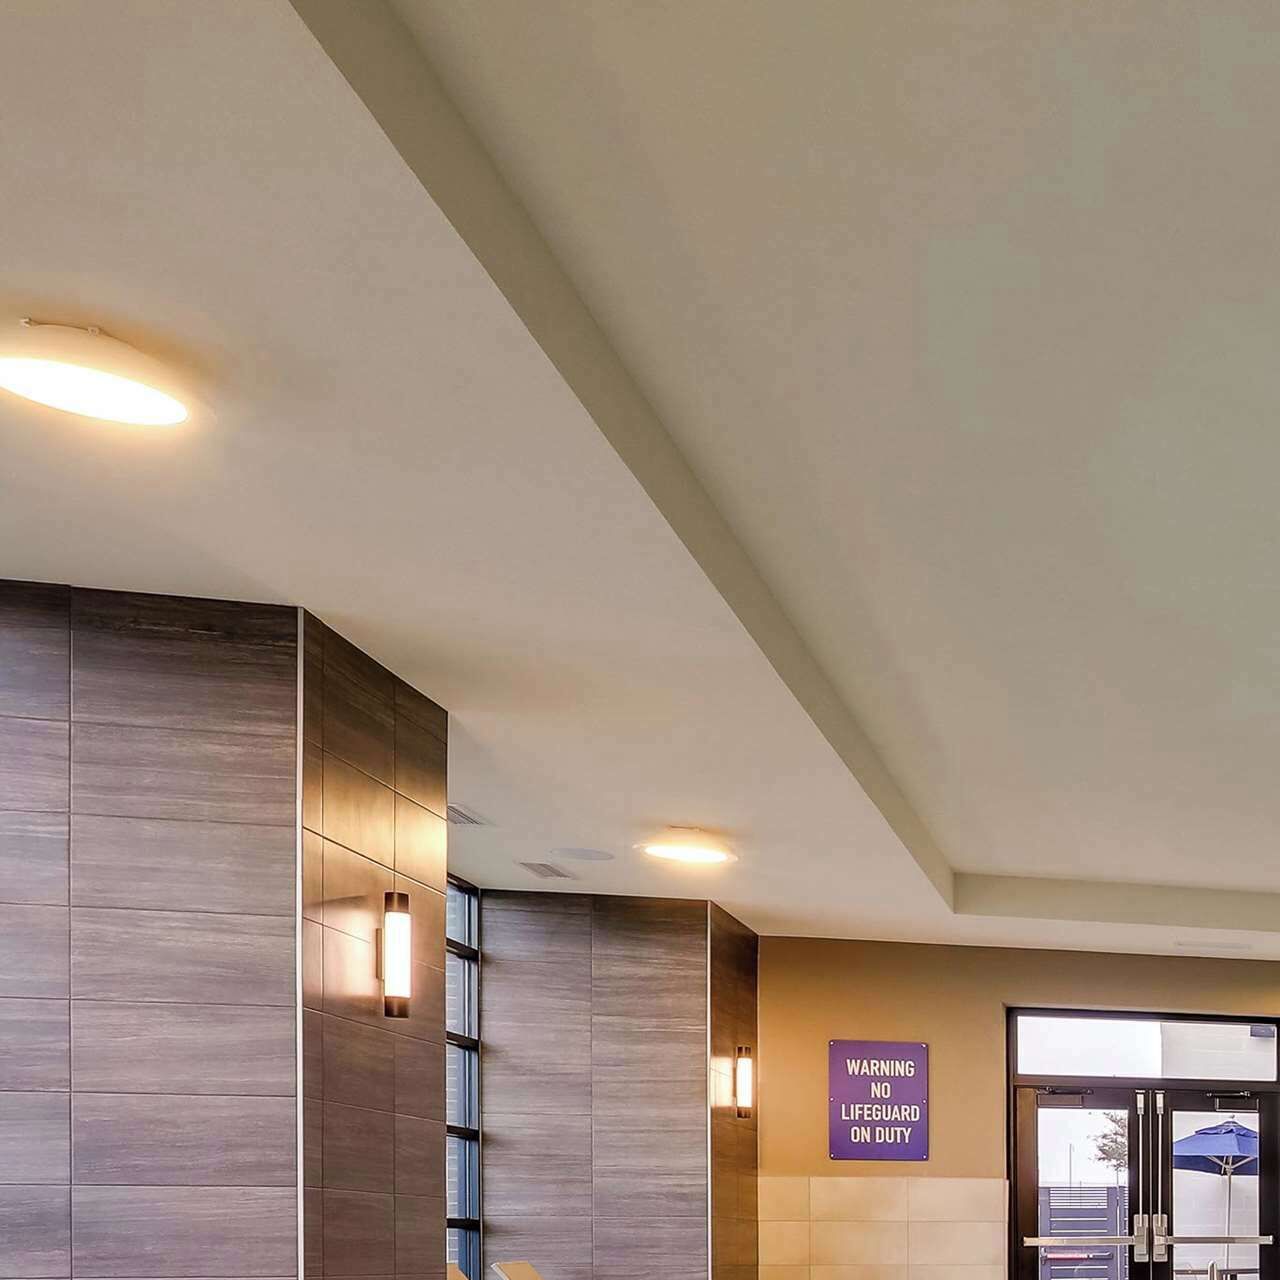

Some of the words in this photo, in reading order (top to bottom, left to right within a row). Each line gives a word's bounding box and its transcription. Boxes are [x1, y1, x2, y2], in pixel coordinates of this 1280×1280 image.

[846, 1059, 915, 1077] WARNING
[871, 1082, 891, 1099] NO
[841, 1104, 920, 1121] LIFEGUARD
[851, 1126, 870, 1143] ON
[876, 1128, 912, 1143] DUTY
